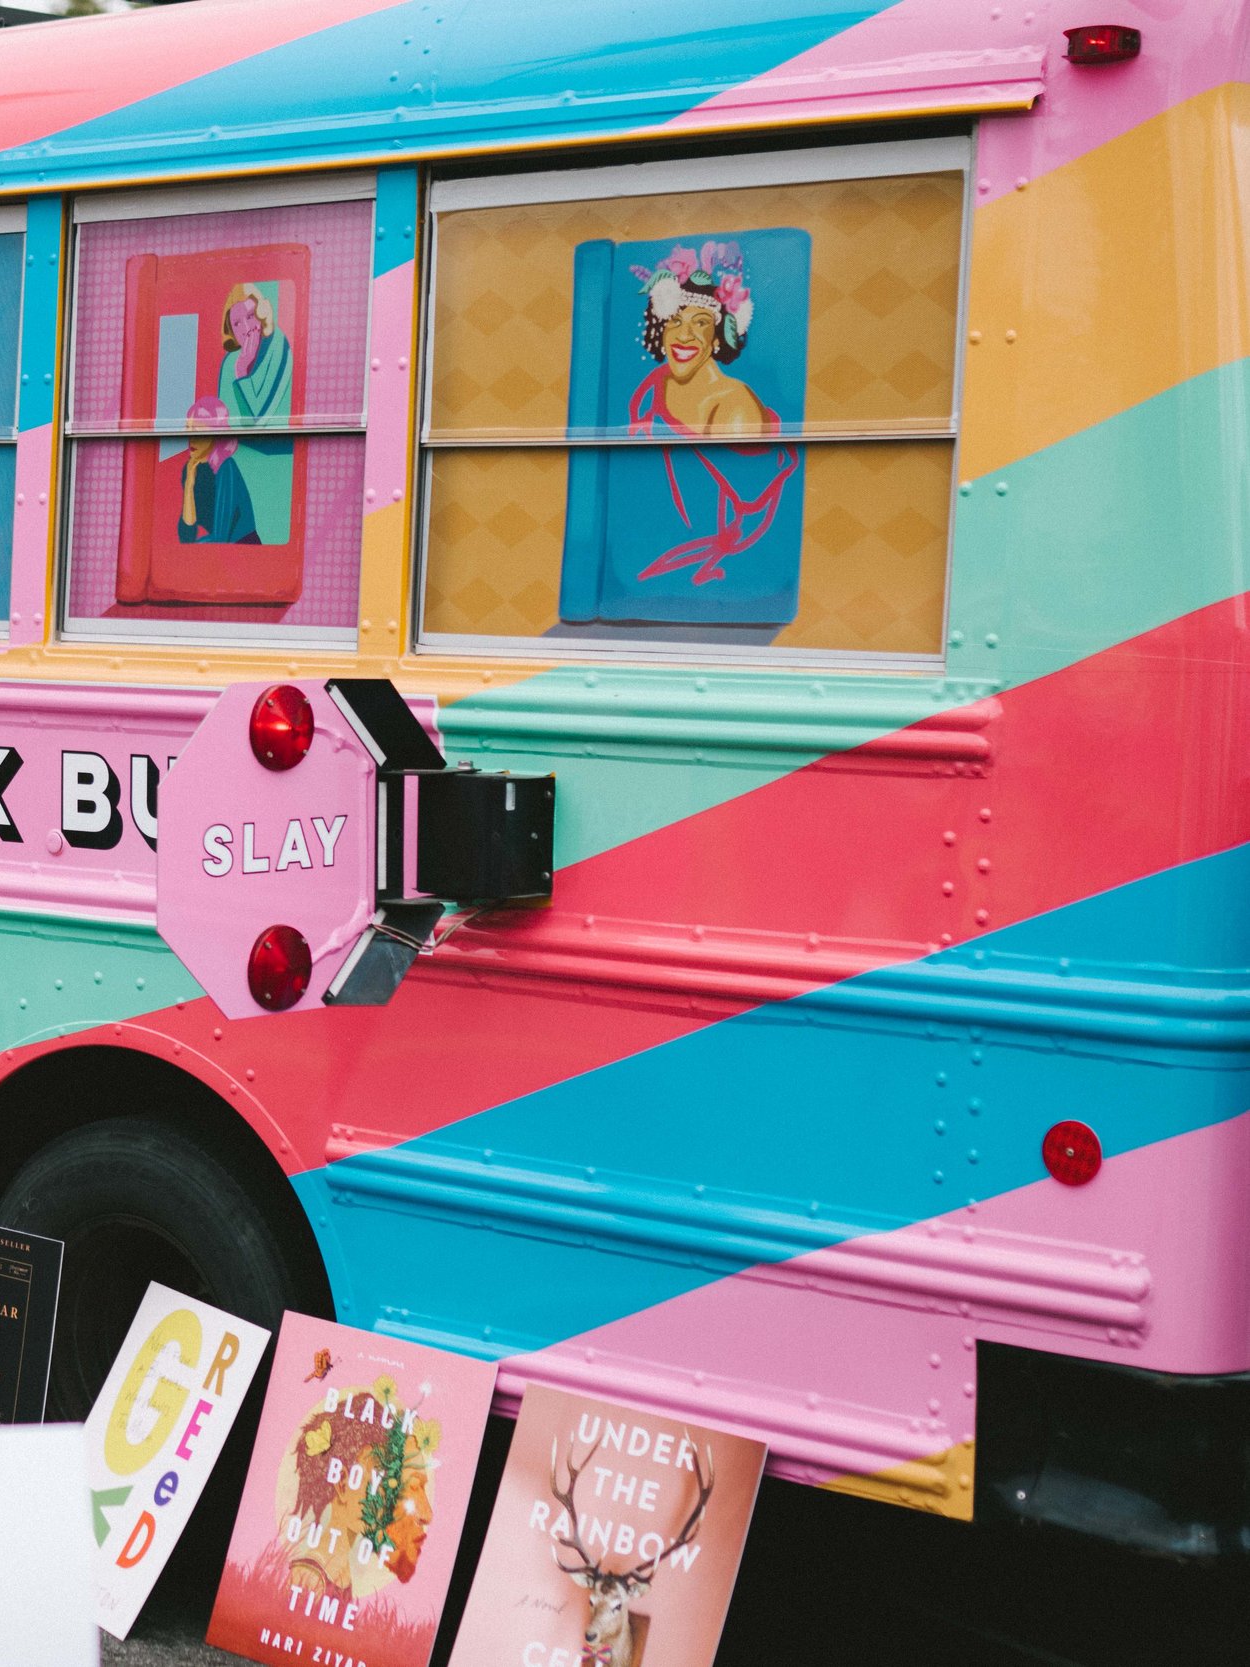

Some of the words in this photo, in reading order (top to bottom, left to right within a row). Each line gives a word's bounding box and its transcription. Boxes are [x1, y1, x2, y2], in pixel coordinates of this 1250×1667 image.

[62, 750, 176, 853] BU
[202, 814, 348, 878] SLAY
[324, 1387, 418, 1435] BLACK
[577, 1412, 698, 1472] UNDER
[326, 1456, 386, 1496] BOY
[594, 1466, 661, 1512] THE
[287, 1515, 342, 1555] OUT
[357, 1537, 394, 1569] OF
[528, 1499, 702, 1574] RAINBOW
[288, 1585, 359, 1631] TIME
[260, 1628, 302, 1656] HARI
